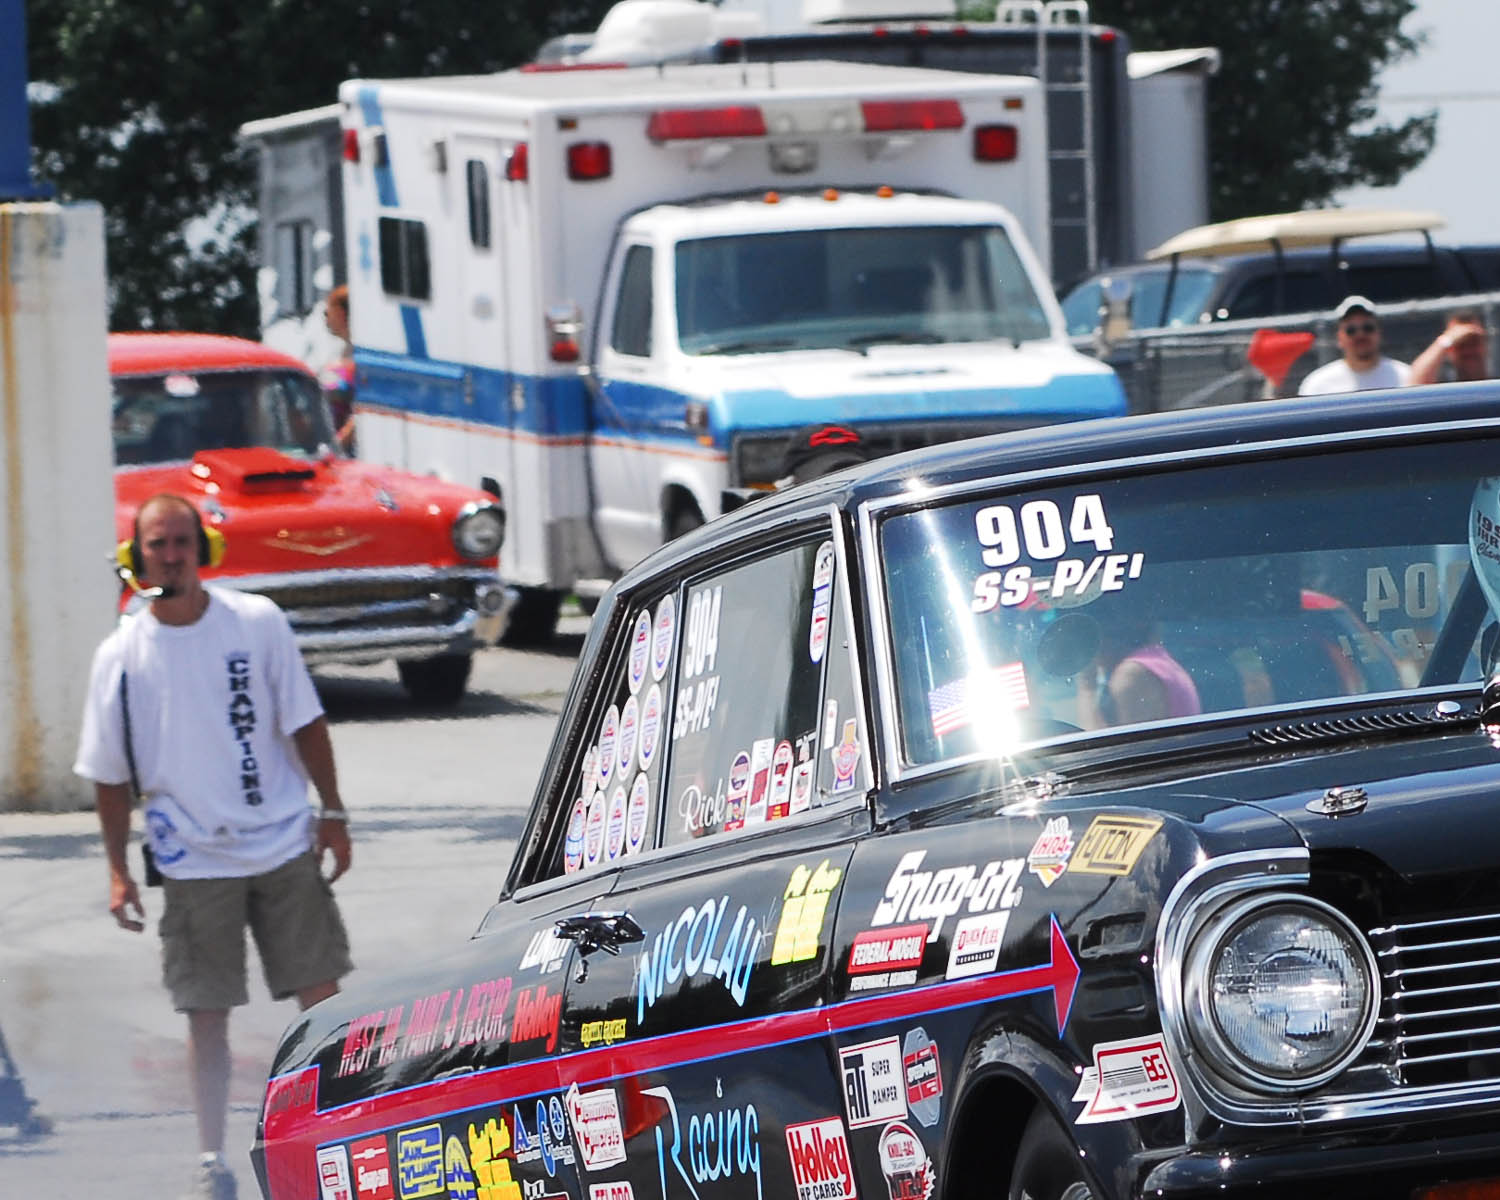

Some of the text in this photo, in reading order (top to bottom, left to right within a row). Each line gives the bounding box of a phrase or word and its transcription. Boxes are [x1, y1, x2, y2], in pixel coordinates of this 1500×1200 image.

[975, 494, 1114, 568] 904
[684, 586, 723, 679] 904
[226, 658, 263, 807] CHAMPIONS
[678, 778, 726, 833] Rick
[870, 850, 1026, 943] Snap-on
[637, 895, 762, 1026] NICOLAU
[851, 936, 922, 966] FEDERAL-MOGUL
[511, 984, 563, 1053] Holley
[843, 1053, 870, 1120] ATI
[871, 1058, 891, 1077] SUPER
[872, 1085, 898, 1105] DAMPER
[1142, 1054, 1168, 1081] BG
[788, 1126, 853, 1195] Holley
[799, 1180, 844, 1200] HP CARBS
